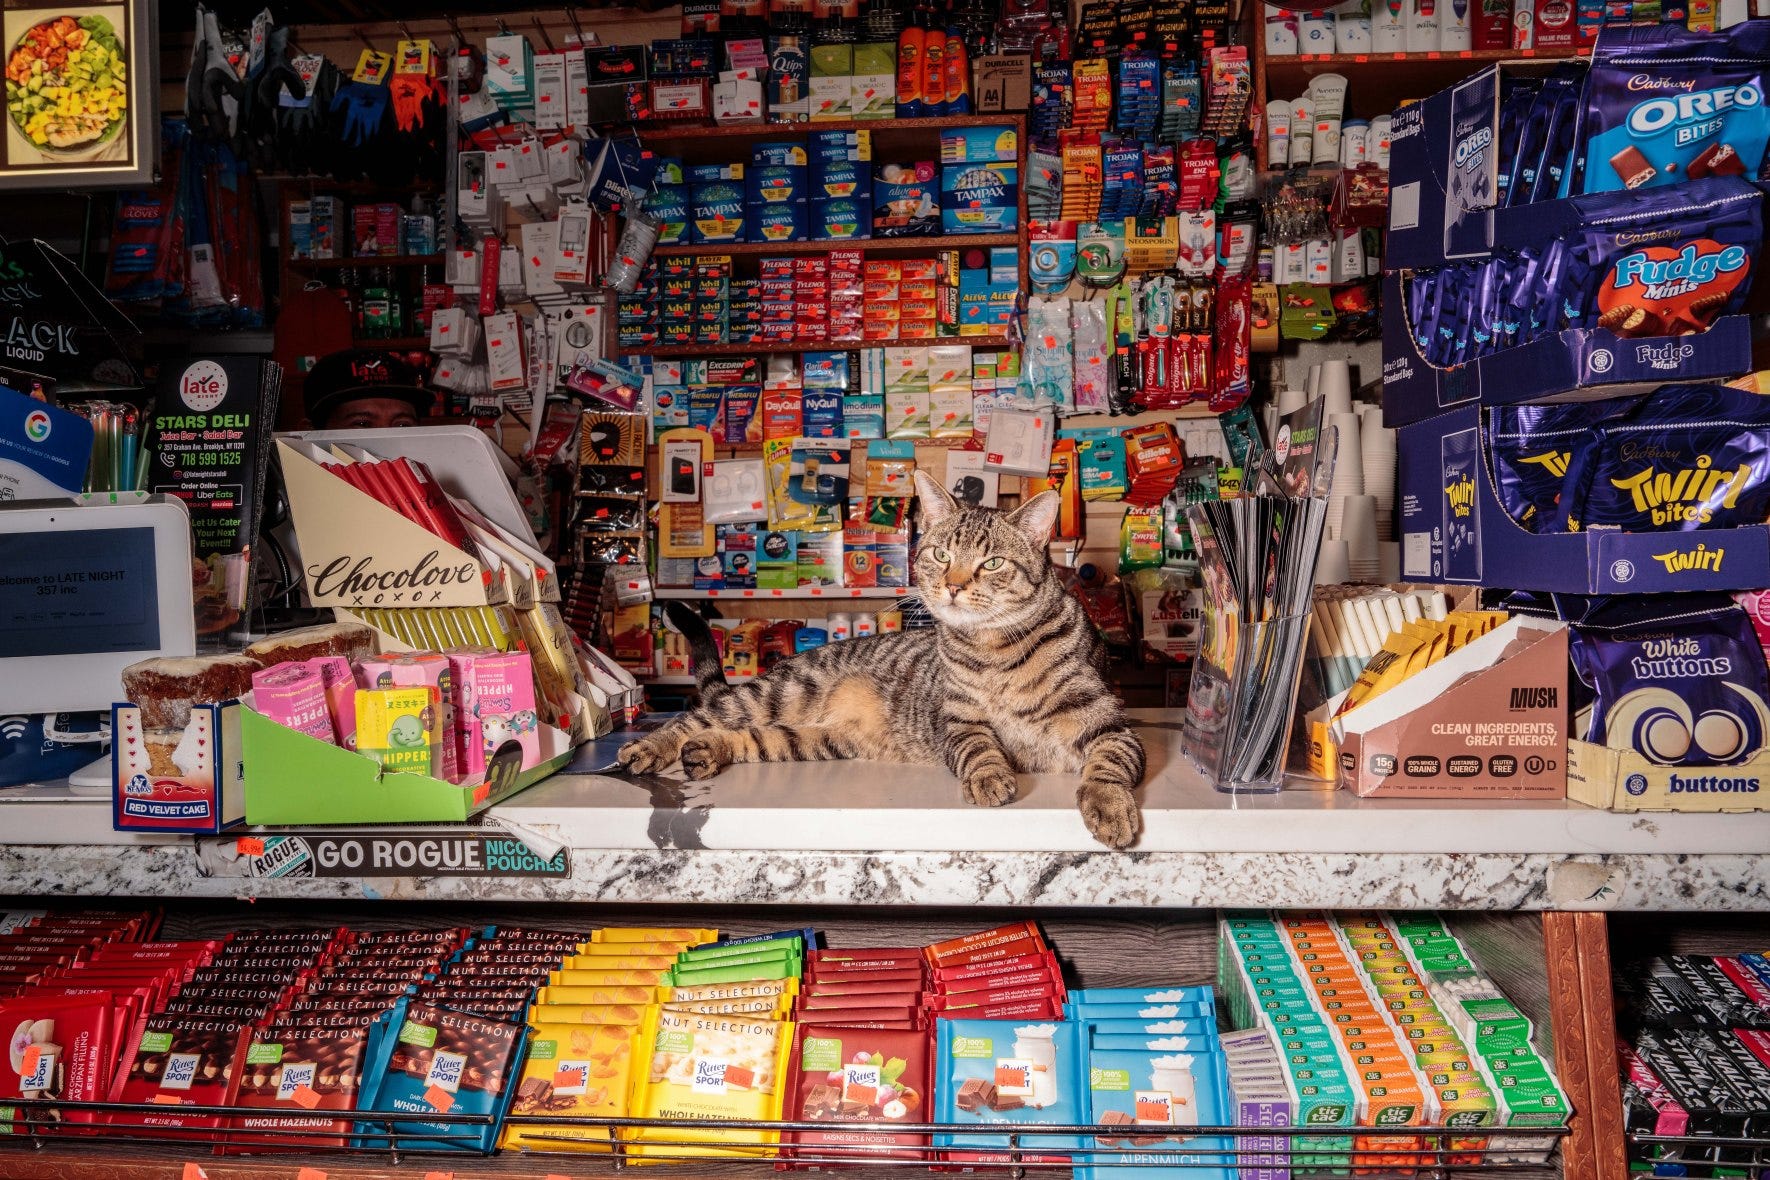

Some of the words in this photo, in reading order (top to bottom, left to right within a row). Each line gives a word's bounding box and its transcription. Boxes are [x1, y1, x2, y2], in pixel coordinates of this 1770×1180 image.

[684, 4, 720, 13] DURACELL
[1195, 6, 1228, 16] MAGNUM
[1120, 12, 1153, 24] MAGNUM
[1085, 20, 1116, 31] MAGNUM
[984, 60, 1024, 68] DURACELL
[1123, 61, 1156, 69] TROJAN
[1167, 78, 1198, 86] TROJAN
[1628, 74, 1696, 92] Cadbury
[984, 89, 998, 102] AA
[1631, 86, 1758, 132] OREO
[1678, 118, 1724, 145] BITES
[1456, 128, 1491, 168] OREO
[1106, 154, 1139, 162] TROJAN
[1467, 150, 1484, 174] BITES
[824, 173, 855, 183] TAMPAX
[954, 186, 1004, 202] TAMPAX
[694, 203, 743, 218] TAMPAX
[1615, 228, 1682, 247] Cadbury
[666, 258, 690, 266] Advil
[762, 260, 792, 268] TYLENOL
[1614, 246, 1746, 287] Fudge
[666, 280, 690, 289] Advil
[762, 282, 792, 290] TYLENOL
[1644, 280, 1700, 300] Minis
[963, 294, 987, 302] ALEVE
[990, 292, 1016, 300] ALEVE
[666, 304, 690, 312] Advil
[6, 346, 44, 362] LIQUID
[1636, 344, 1694, 364] Fudge
[1650, 360, 1678, 370] Minis
[692, 392, 720, 400] THERAFLU
[766, 401, 801, 411] DayQuil
[806, 399, 838, 411] NyQuil
[844, 402, 880, 411] Imodium
[156, 415, 206, 430] STARS
[212, 414, 250, 428] DELI
[160, 431, 180, 440] Juice
[181, 430, 196, 440] Bar
[202, 430, 226, 440] Salad
[227, 430, 243, 440] Bar
[204, 442, 224, 451] Brooklyn,
[226, 442, 232, 450] NY
[1621, 442, 1681, 463] Cadbury
[182, 453, 196, 466] 718
[199, 452, 216, 466] 599
[219, 452, 240, 464] 1525
[1138, 448, 1171, 460] Gillette
[181, 482, 198, 490] Order
[1611, 454, 1752, 513] Twirl
[216, 490, 234, 498] Eats
[1446, 474, 1475, 510] Twirl
[1651, 502, 1714, 526] bites
[220, 518, 241, 526] Cater
[1132, 532, 1158, 540] ZYRTEC
[200, 539, 231, 547] Event!!!
[1652, 543, 1724, 574] Twirl
[0, 574, 40, 585] elcome
[42, 576, 54, 584] to
[57, 572, 86, 584] LATE
[88, 570, 125, 582] NIGHT
[308, 550, 474, 598] Chocolove
[36, 586, 58, 595] 357
[60, 586, 78, 594] inc
[1642, 640, 1701, 658] White
[1632, 656, 1731, 679] buttons
[1510, 688, 1558, 708] MUSH
[1432, 724, 1470, 735] CLEAN
[1475, 723, 1558, 736] INGREDIENTS,
[1465, 736, 1502, 746] GREAT
[1508, 736, 1558, 746] ENERGY.
[1376, 757, 1393, 770] 15g
[1548, 760, 1556, 770] D
[1408, 766, 1437, 774] GRAINS
[1450, 766, 1479, 774] ENERGY
[1670, 774, 1760, 794] buttons
[129, 803, 148, 813] RED
[149, 804, 180, 815] VELVET
[182, 804, 206, 814] CAKE
[254, 836, 299, 875] ROGUE
[318, 840, 364, 868] GO
[372, 840, 481, 868] ROGUE
[487, 856, 566, 872] POUCHES
[216, 959, 240, 967] NUT
[244, 958, 310, 968] SELECTION
[182, 988, 206, 996] NUT
[211, 988, 277, 999] SELECTION
[168, 1004, 192, 1012] NUT
[197, 1004, 263, 1017] SELECTION
[410, 1008, 434, 1022] NUT
[441, 1016, 514, 1040] SELECTION
[662, 1016, 689, 1027] NUT
[698, 1020, 774, 1036] SELECTION
[254, 1030, 279, 1040] NUT
[286, 1030, 360, 1040] SELECTION
[80, 1030, 89, 1062] FILLING
[170, 1058, 194, 1072] Ritter
[436, 1056, 462, 1073] Ritter
[1664, 1038, 1714, 1081] HALLS
[38, 1057, 48, 1086] SPORT
[166, 1072, 191, 1082] SPORT
[284, 1068, 312, 1082] Ritter
[430, 1070, 458, 1084] SPORT
[1651, 1053, 1702, 1097] HALLS
[1708, 1055, 1762, 1098] HALLS
[1319, 1107, 1339, 1115] tic
[1388, 1106, 1408, 1114] tic
[244, 1118, 278, 1127] WHOLE
[280, 1118, 333, 1127] HAZELNUTS
[1312, 1114, 1337, 1122] tac
[1381, 1114, 1406, 1122] tac
[866, 1136, 896, 1144] NOISETTES
[1120, 1153, 1200, 1164] ALPENMILCH
